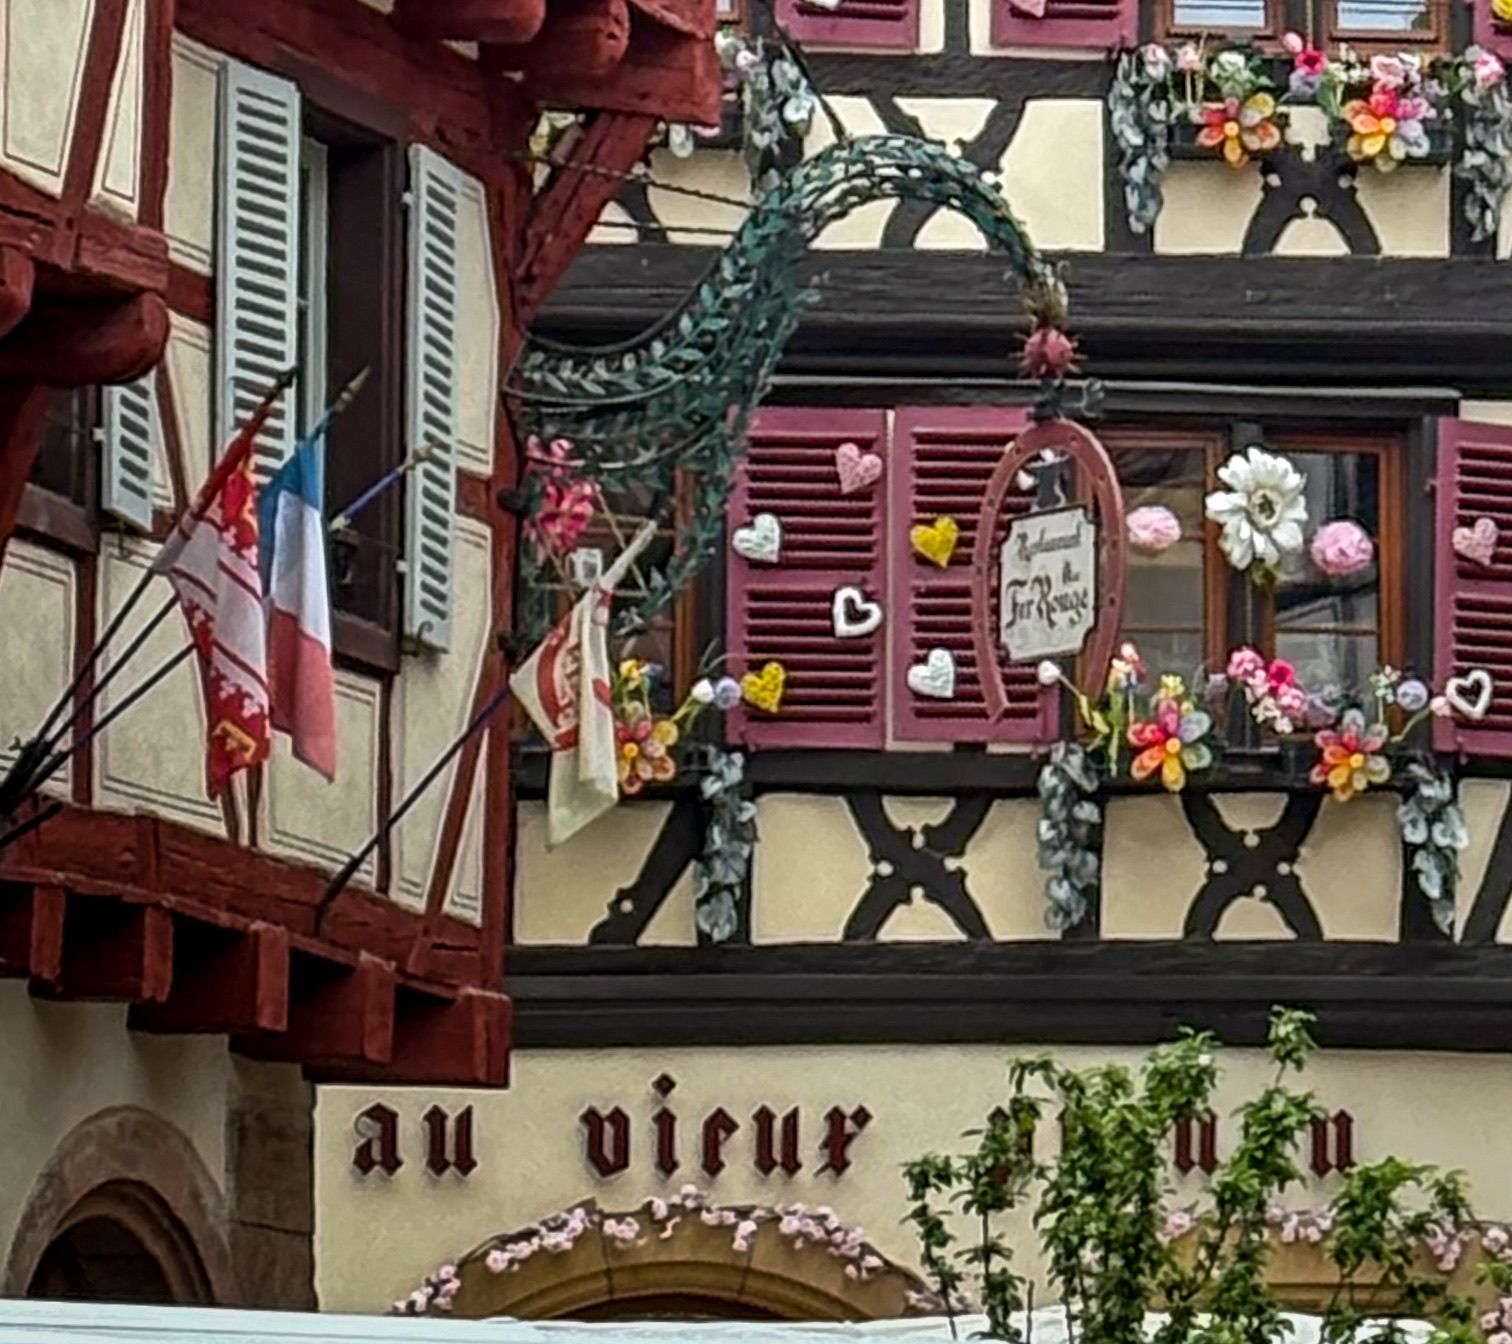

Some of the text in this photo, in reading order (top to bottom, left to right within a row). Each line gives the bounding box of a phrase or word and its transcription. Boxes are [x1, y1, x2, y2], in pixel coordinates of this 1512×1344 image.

[1030, 573, 1089, 629] Rouge
[353, 1072, 874, 1177] au vieux
